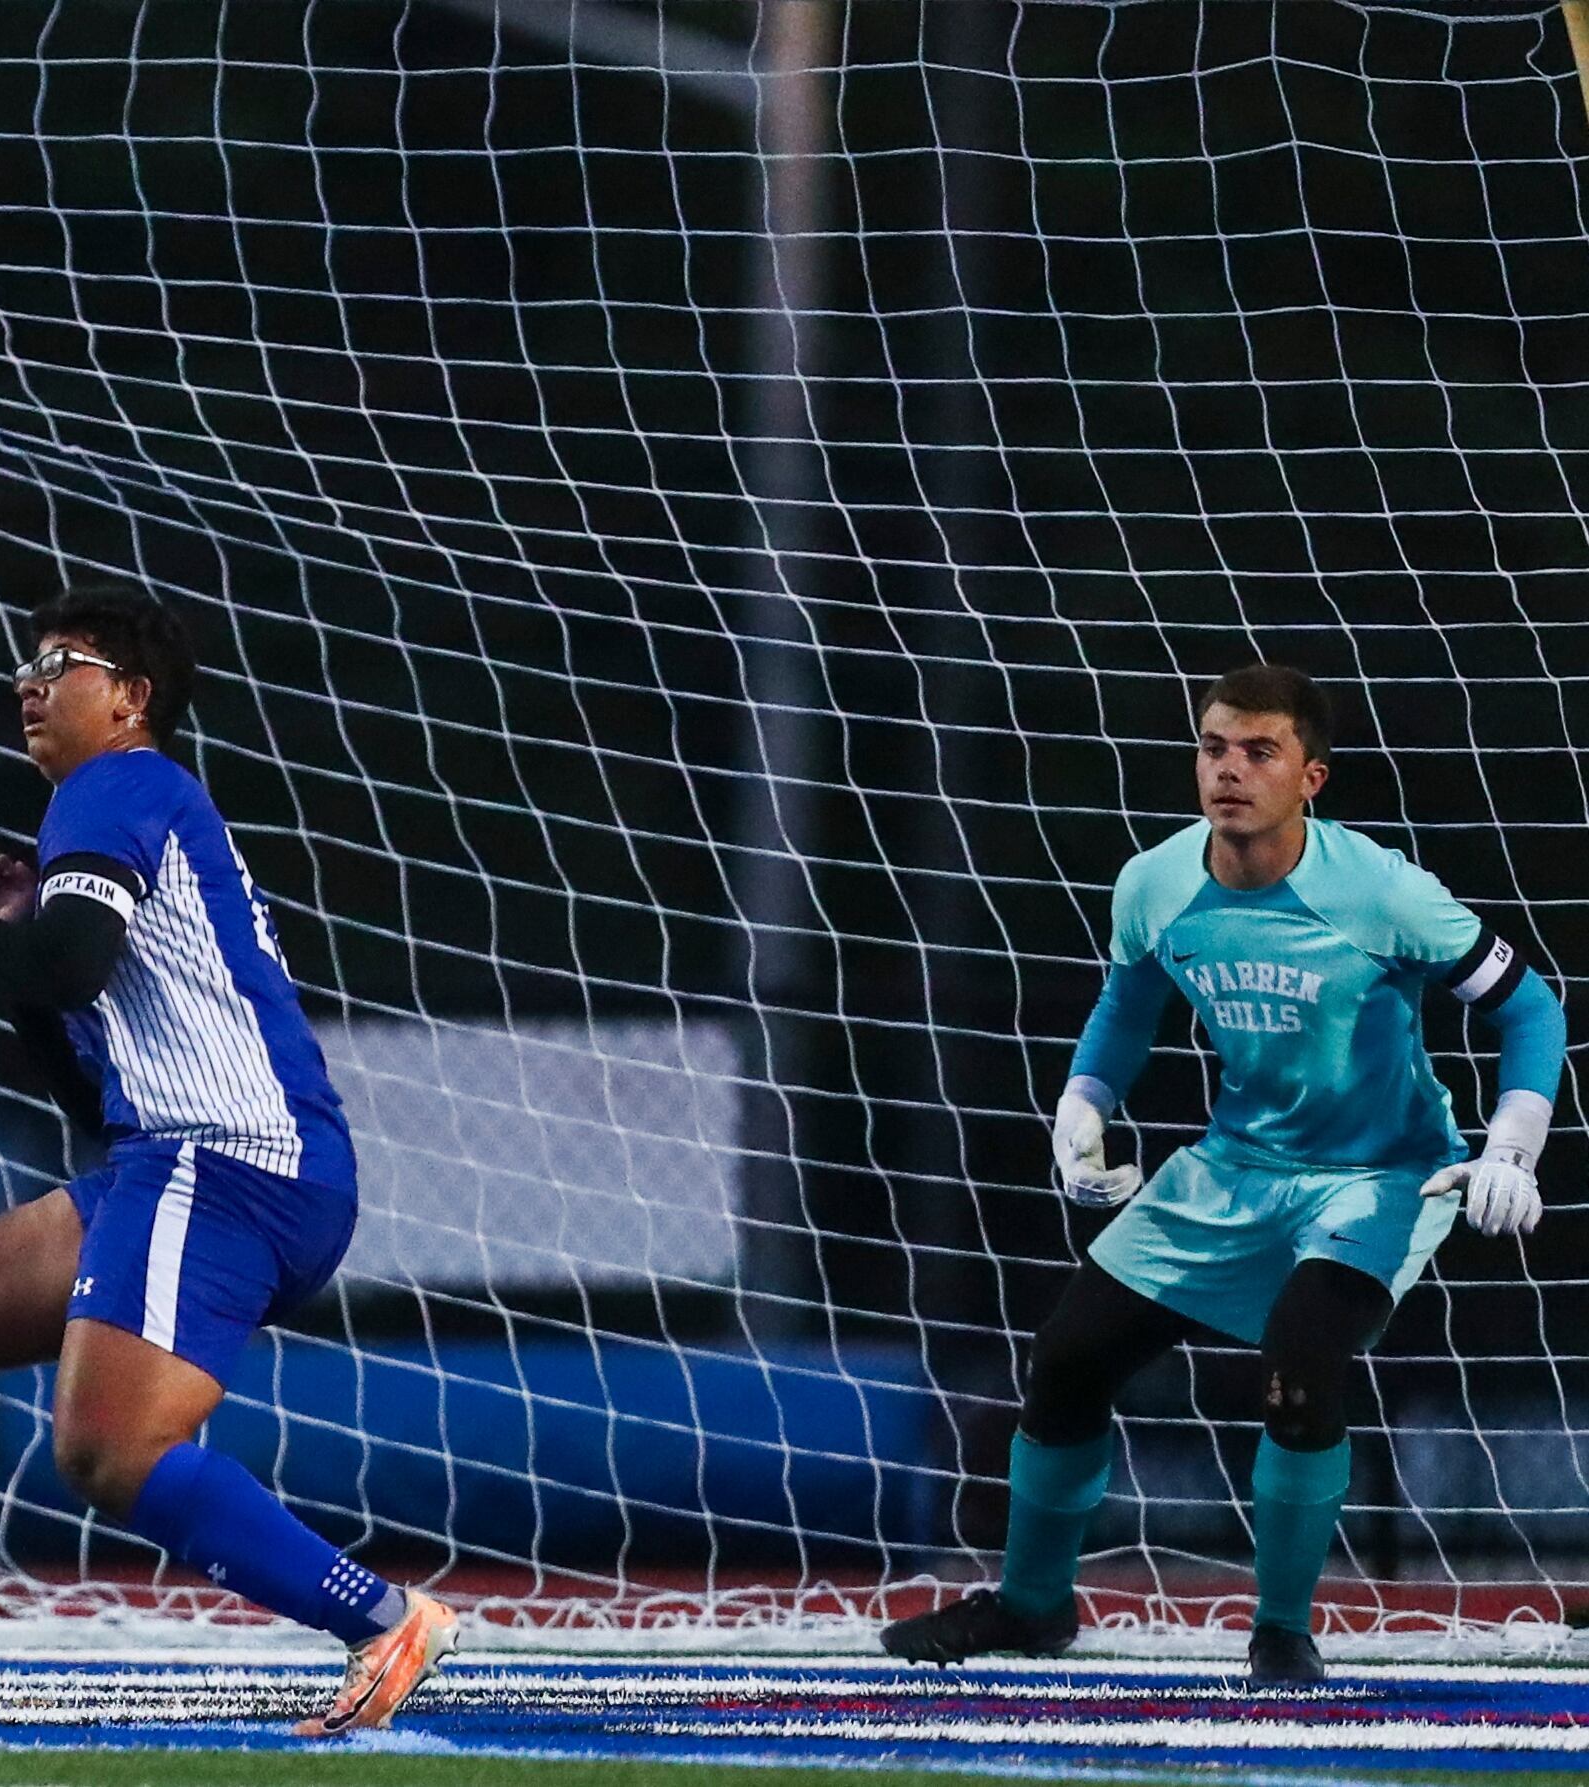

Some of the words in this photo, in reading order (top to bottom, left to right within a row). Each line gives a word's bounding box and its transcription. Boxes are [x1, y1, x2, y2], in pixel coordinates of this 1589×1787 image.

[47, 875, 115, 902] CAPTAIN
[1185, 961, 1324, 1004] WARREN
[1211, 999, 1302, 1033] HILLS
